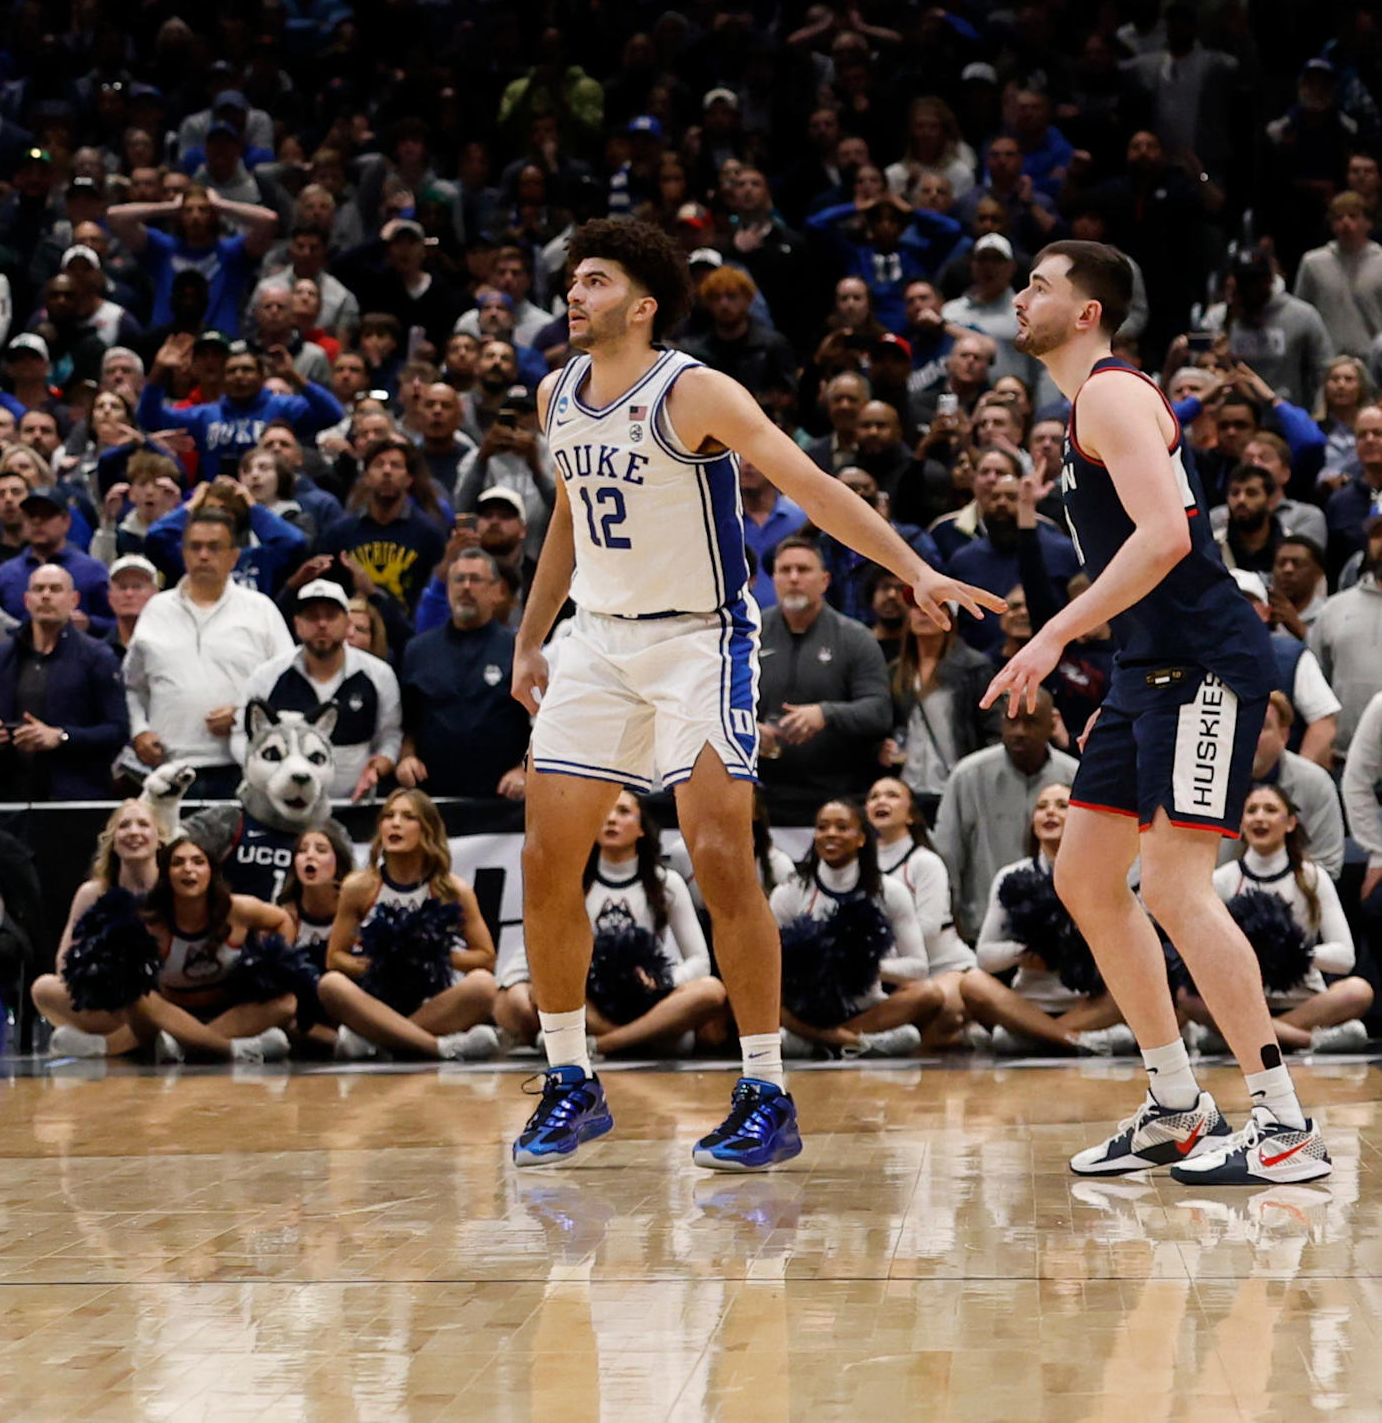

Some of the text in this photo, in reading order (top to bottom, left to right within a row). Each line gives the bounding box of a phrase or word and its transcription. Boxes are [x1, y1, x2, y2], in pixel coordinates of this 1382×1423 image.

[555, 444, 649, 486] DUKE
[580, 486, 632, 550] 12
[236, 844, 292, 868] UCO
